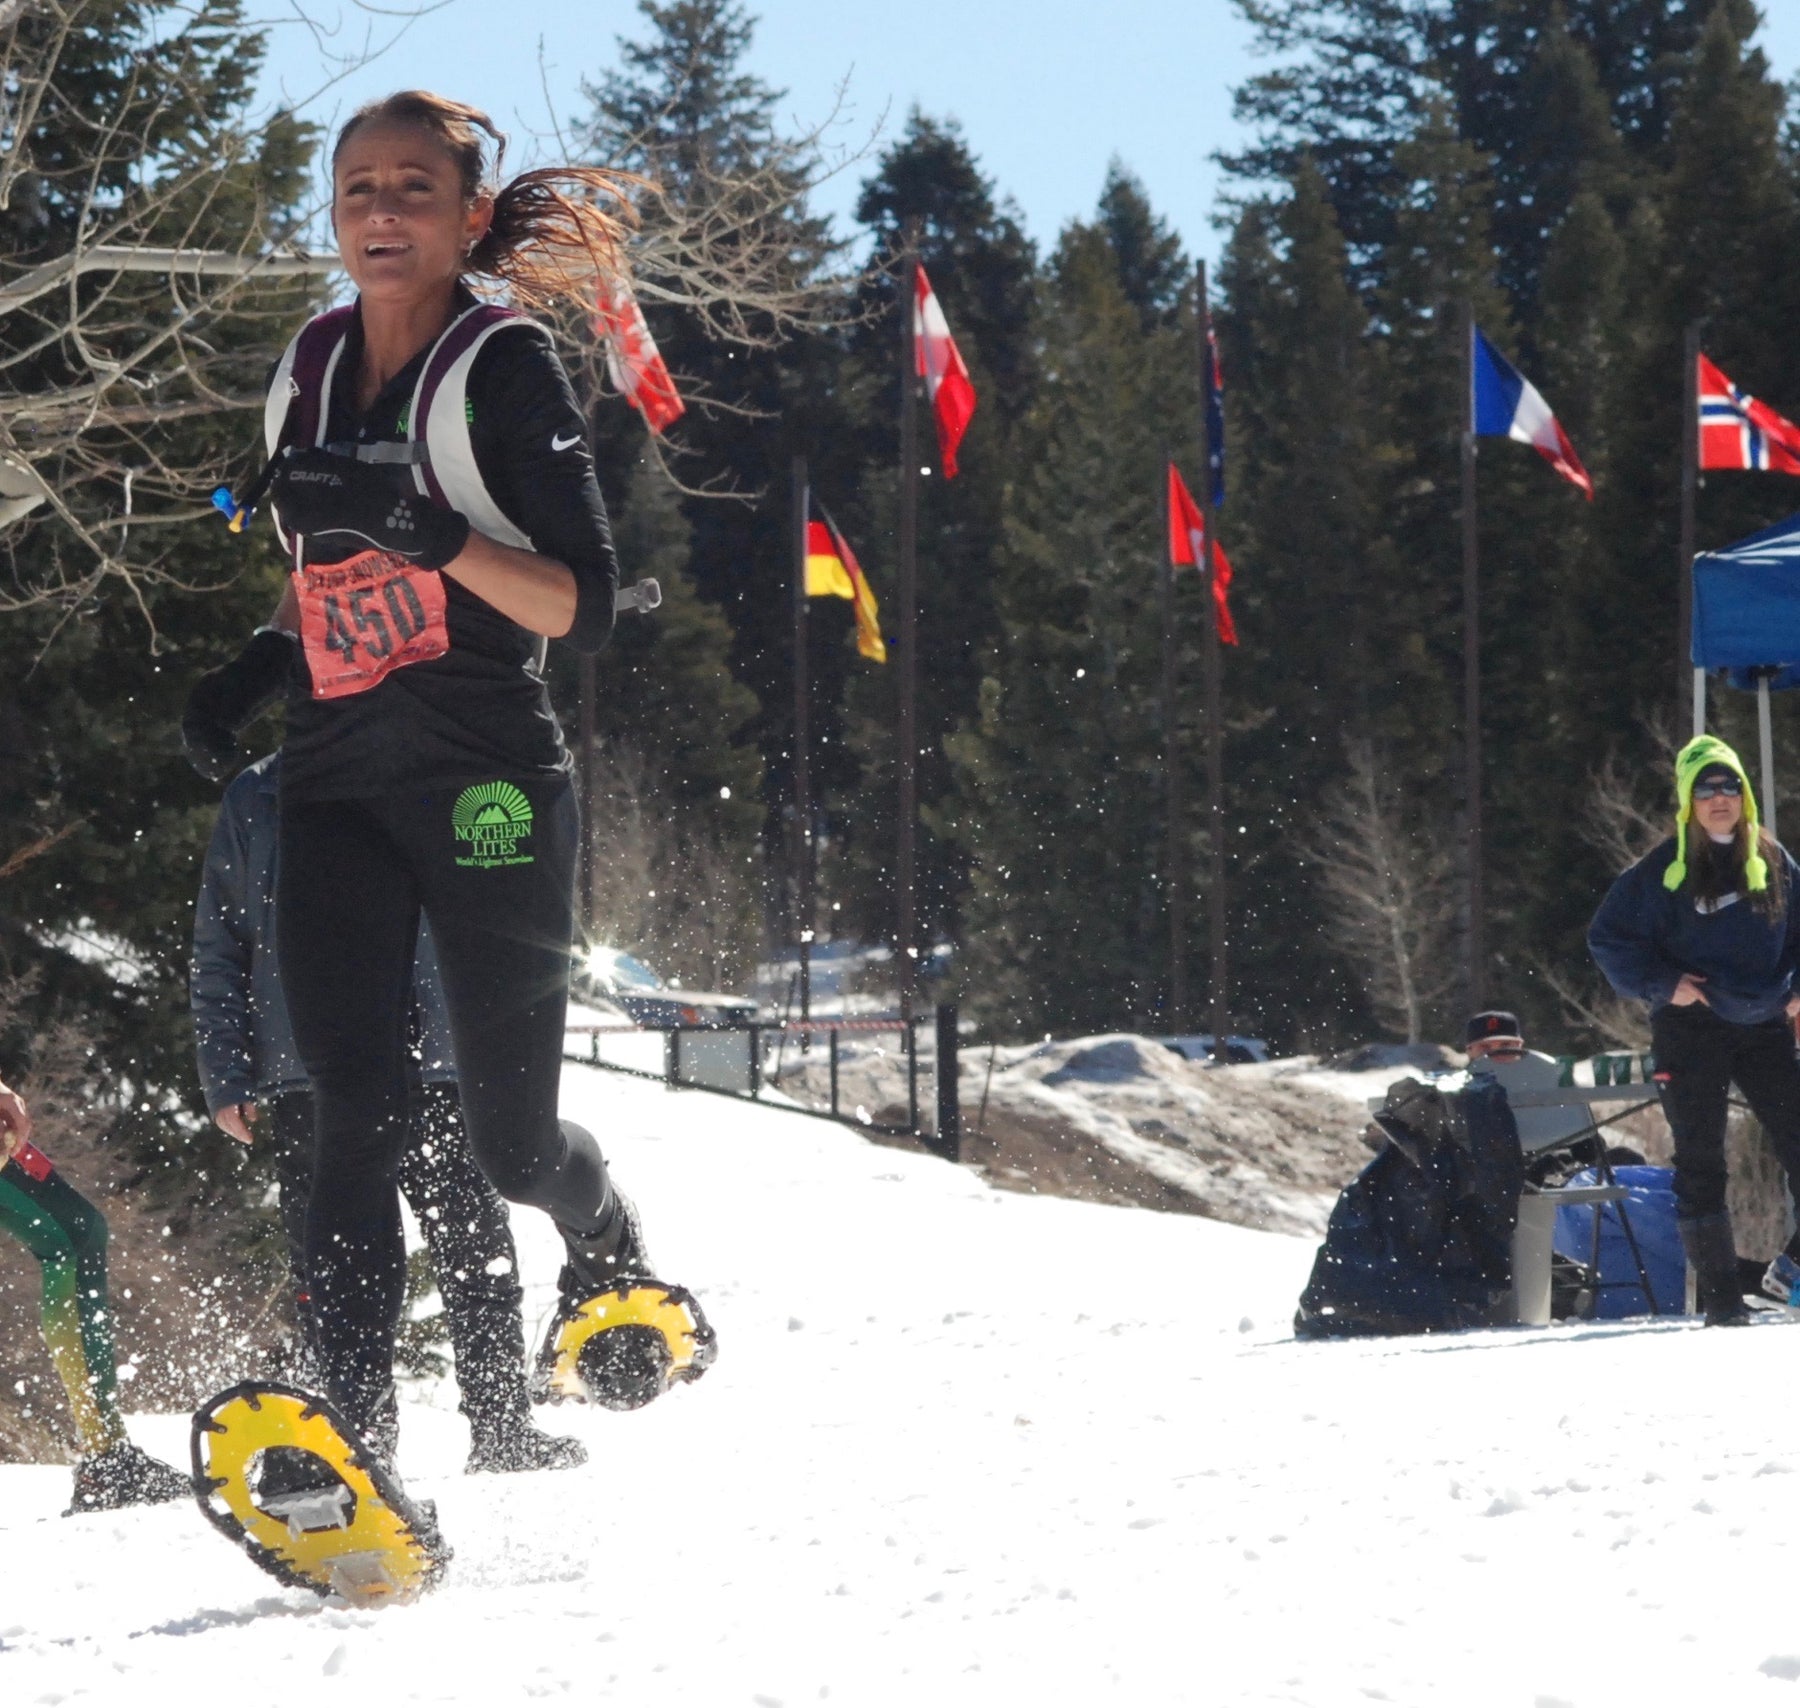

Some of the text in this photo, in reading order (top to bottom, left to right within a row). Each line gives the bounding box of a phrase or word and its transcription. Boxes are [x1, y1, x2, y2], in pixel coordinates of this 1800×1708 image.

[290, 470, 331, 483] CRAFT
[325, 575, 426, 664] 450
[454, 821, 532, 841] NORTHERN
[473, 839, 517, 857] LITES
